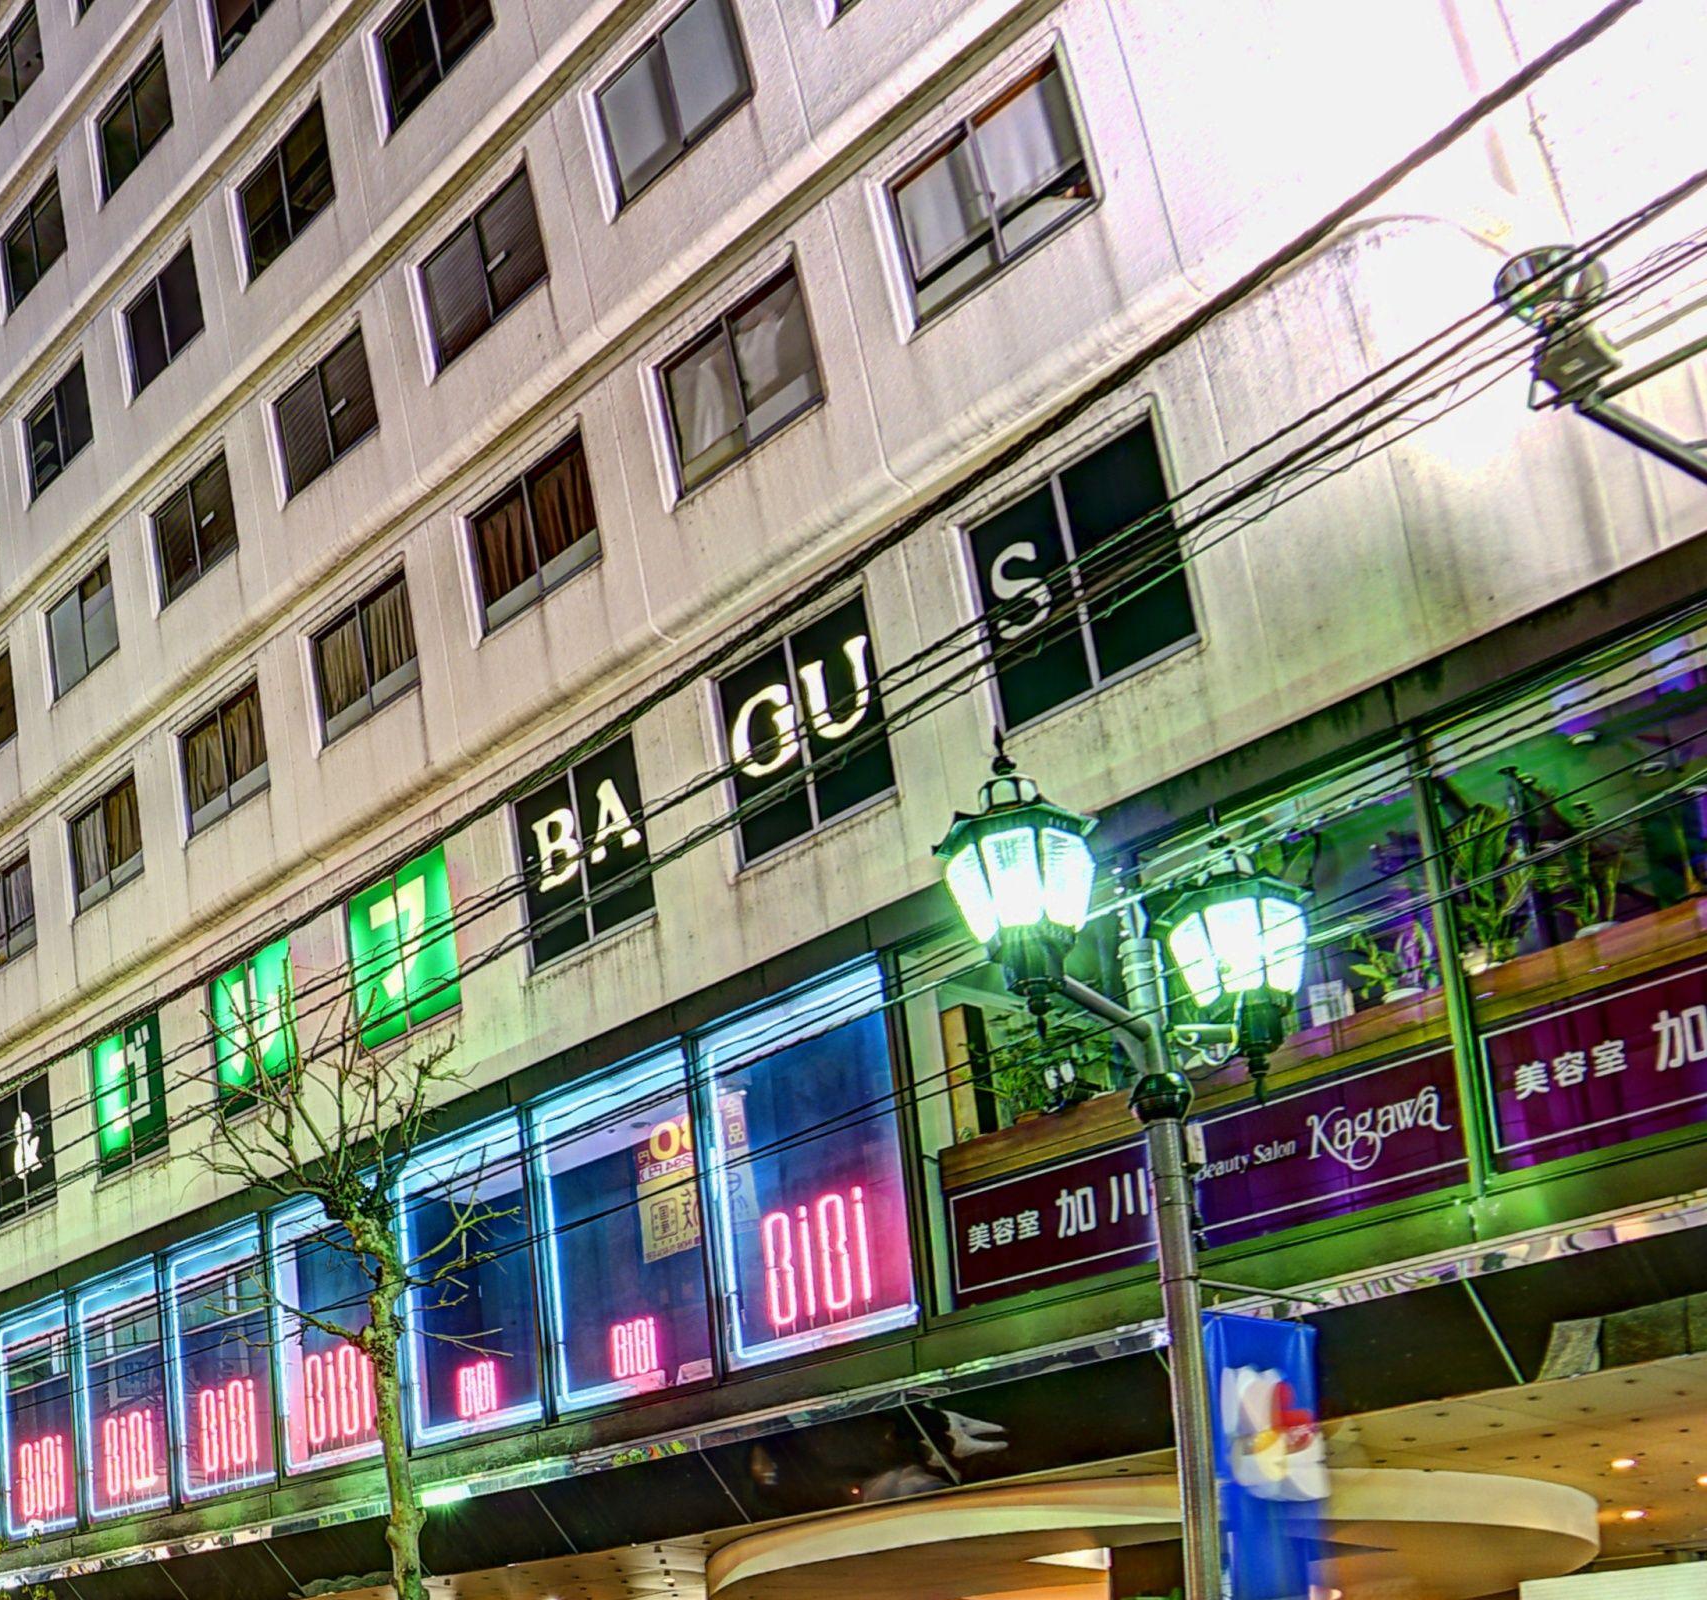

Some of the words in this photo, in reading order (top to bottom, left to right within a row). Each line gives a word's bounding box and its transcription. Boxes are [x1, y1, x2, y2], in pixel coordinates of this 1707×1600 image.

[1512, 1038, 1628, 1101] 美容室
[1253, 1135, 1297, 1165] Salon
[1306, 1085, 1452, 1172] Kagawa
[967, 1208, 1041, 1254] 美容室
[1056, 1166, 1150, 1239] 加川
